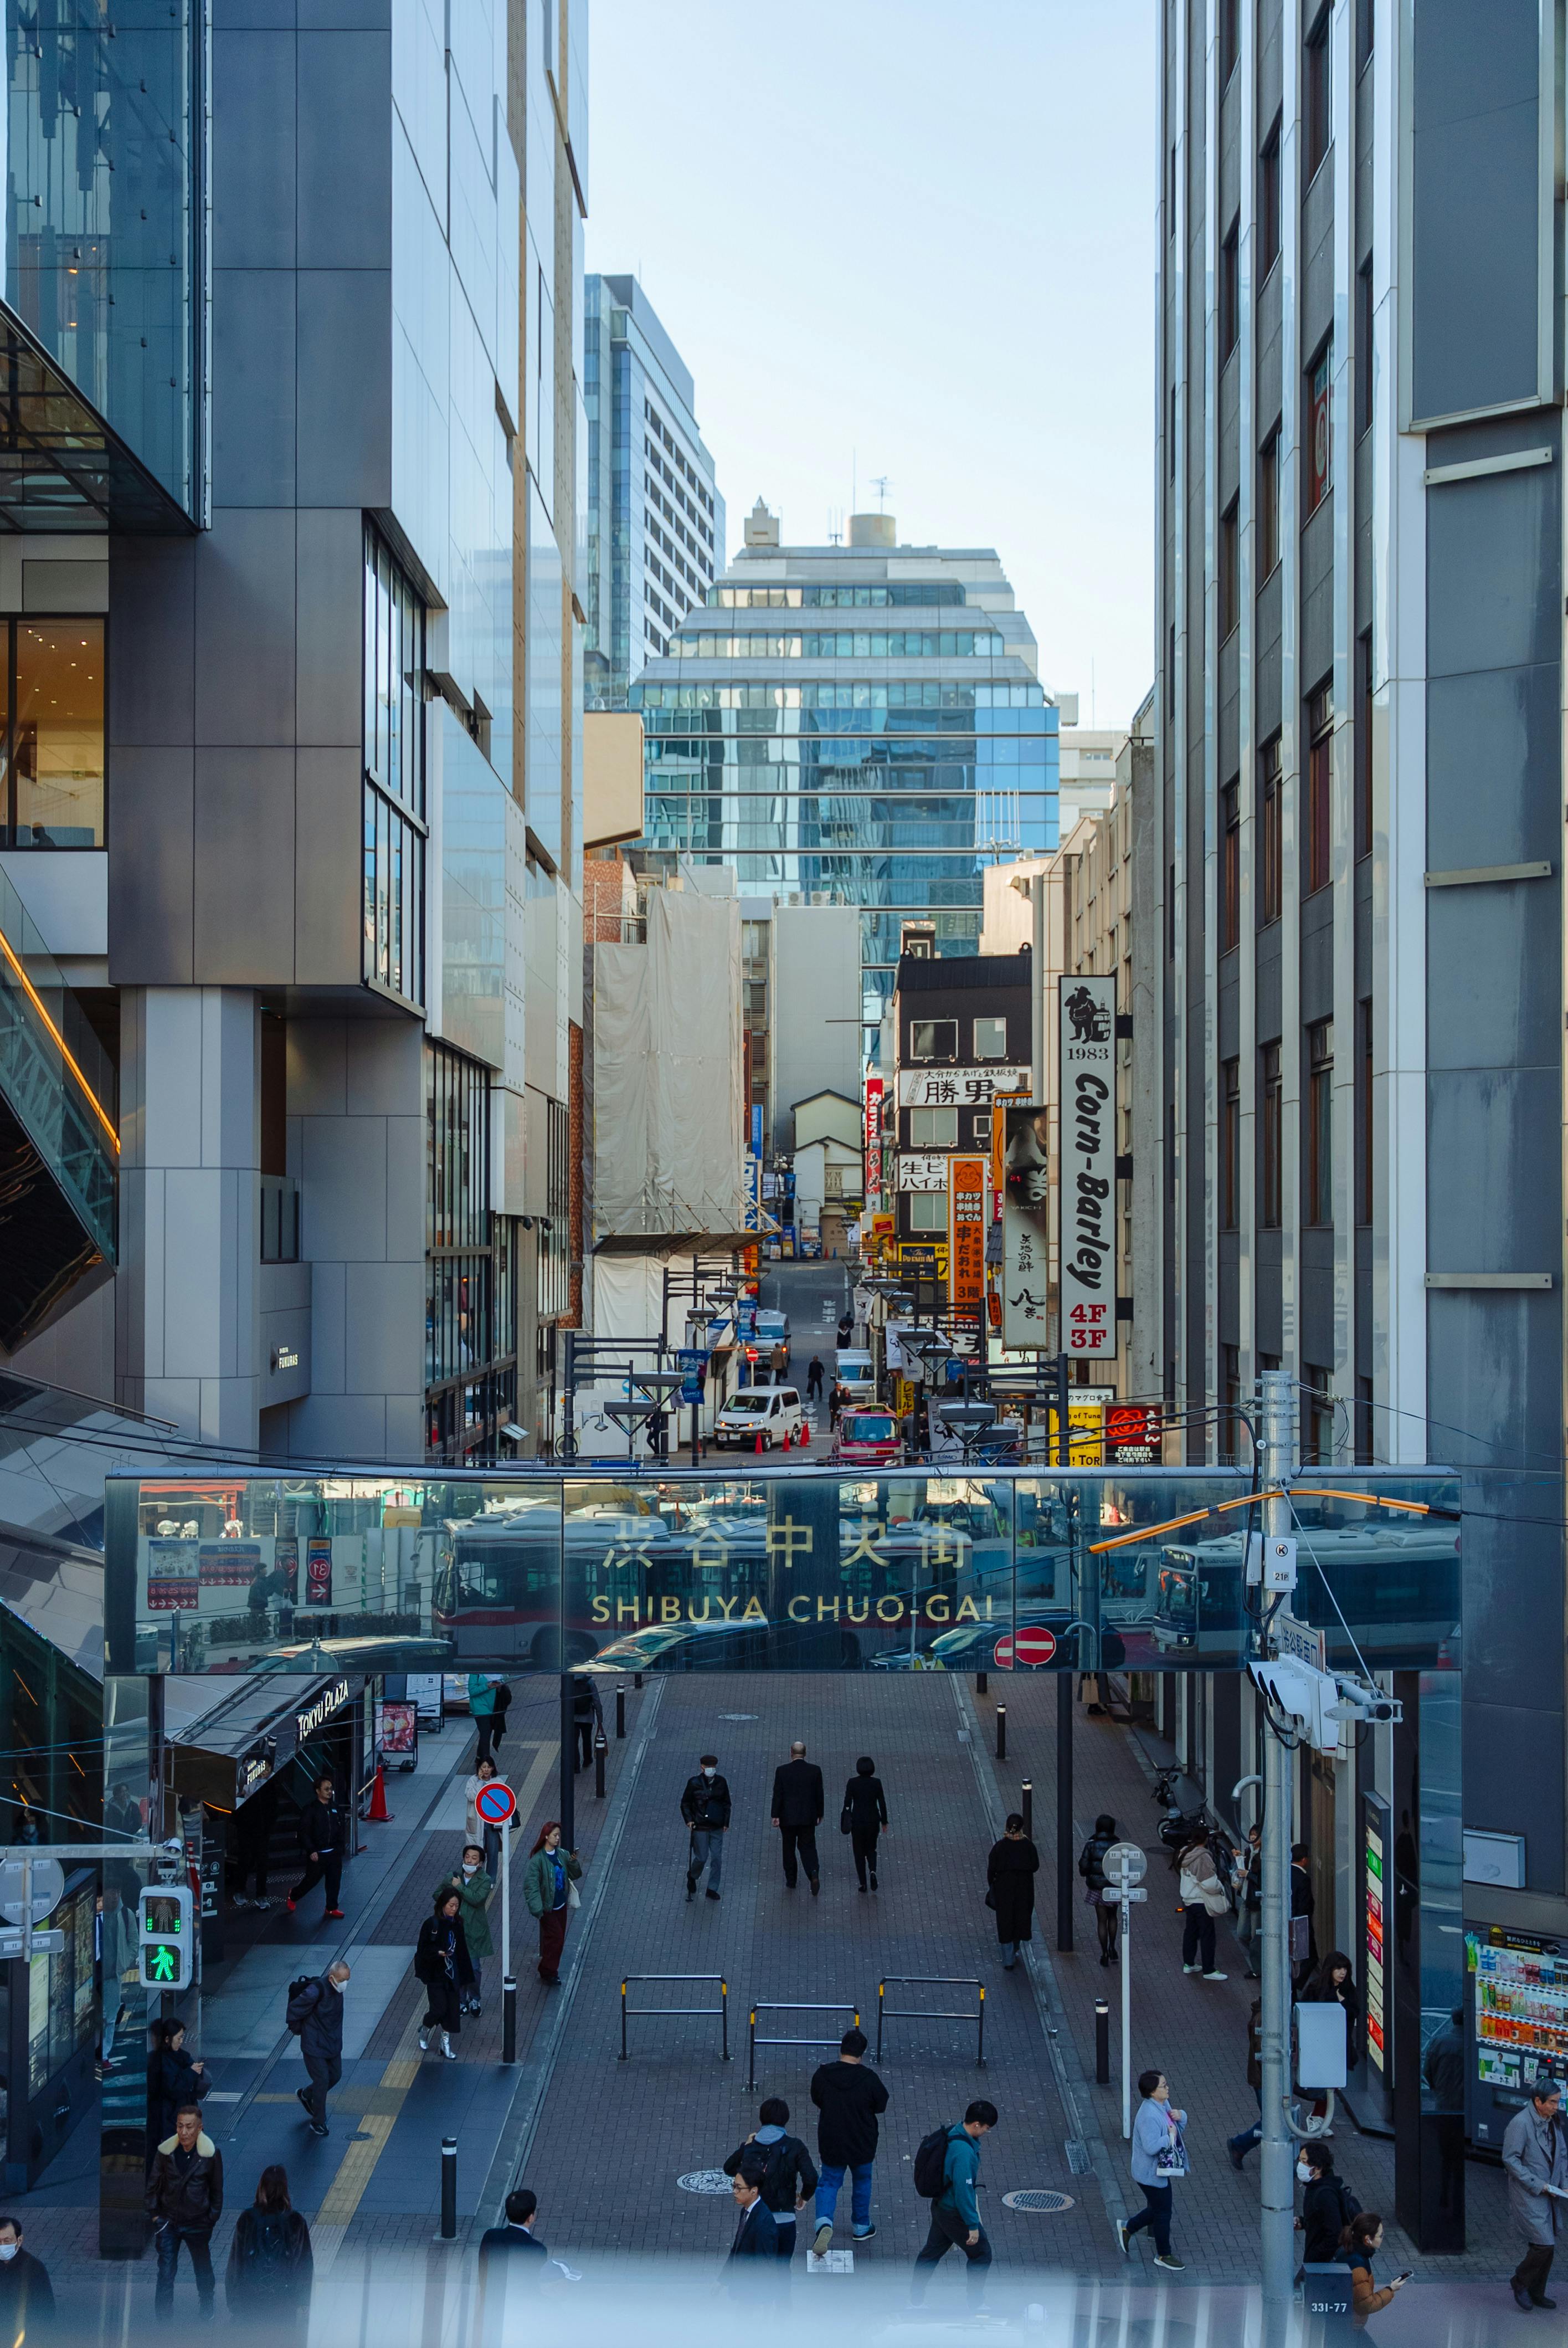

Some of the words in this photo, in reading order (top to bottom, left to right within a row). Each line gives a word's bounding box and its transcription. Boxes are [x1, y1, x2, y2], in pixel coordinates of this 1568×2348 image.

[1067, 1048, 1109, 1060] 1983
[924, 1079, 995, 1104] 勝男
[867, 1153, 880, 1194] ラーメ
[901, 1162, 947, 1175] 生ビ
[1066, 1073, 1111, 1290] Corn-Barley
[957, 1192, 981, 1201] 串カツ
[957, 1213, 982, 1222] おでん
[957, 1225, 973, 1279] 串だおれ
[957, 1286, 980, 1299] 3階
[1070, 1304, 1107, 1323] 4F
[1071, 1329, 1107, 1348] 3F
[603, 1515, 964, 1568] 渋谷中央街
[591, 1595, 765, 1623] SHIBUYA
[787, 1594, 993, 1623] CHUO-GAI
[298, 1701, 323, 1741] TOKYU
[324, 1679, 348, 1717] PLAZA
[247, 1760, 266, 1785] FUKURAS
[1312, 2303, 1346, 2313] 331-77
